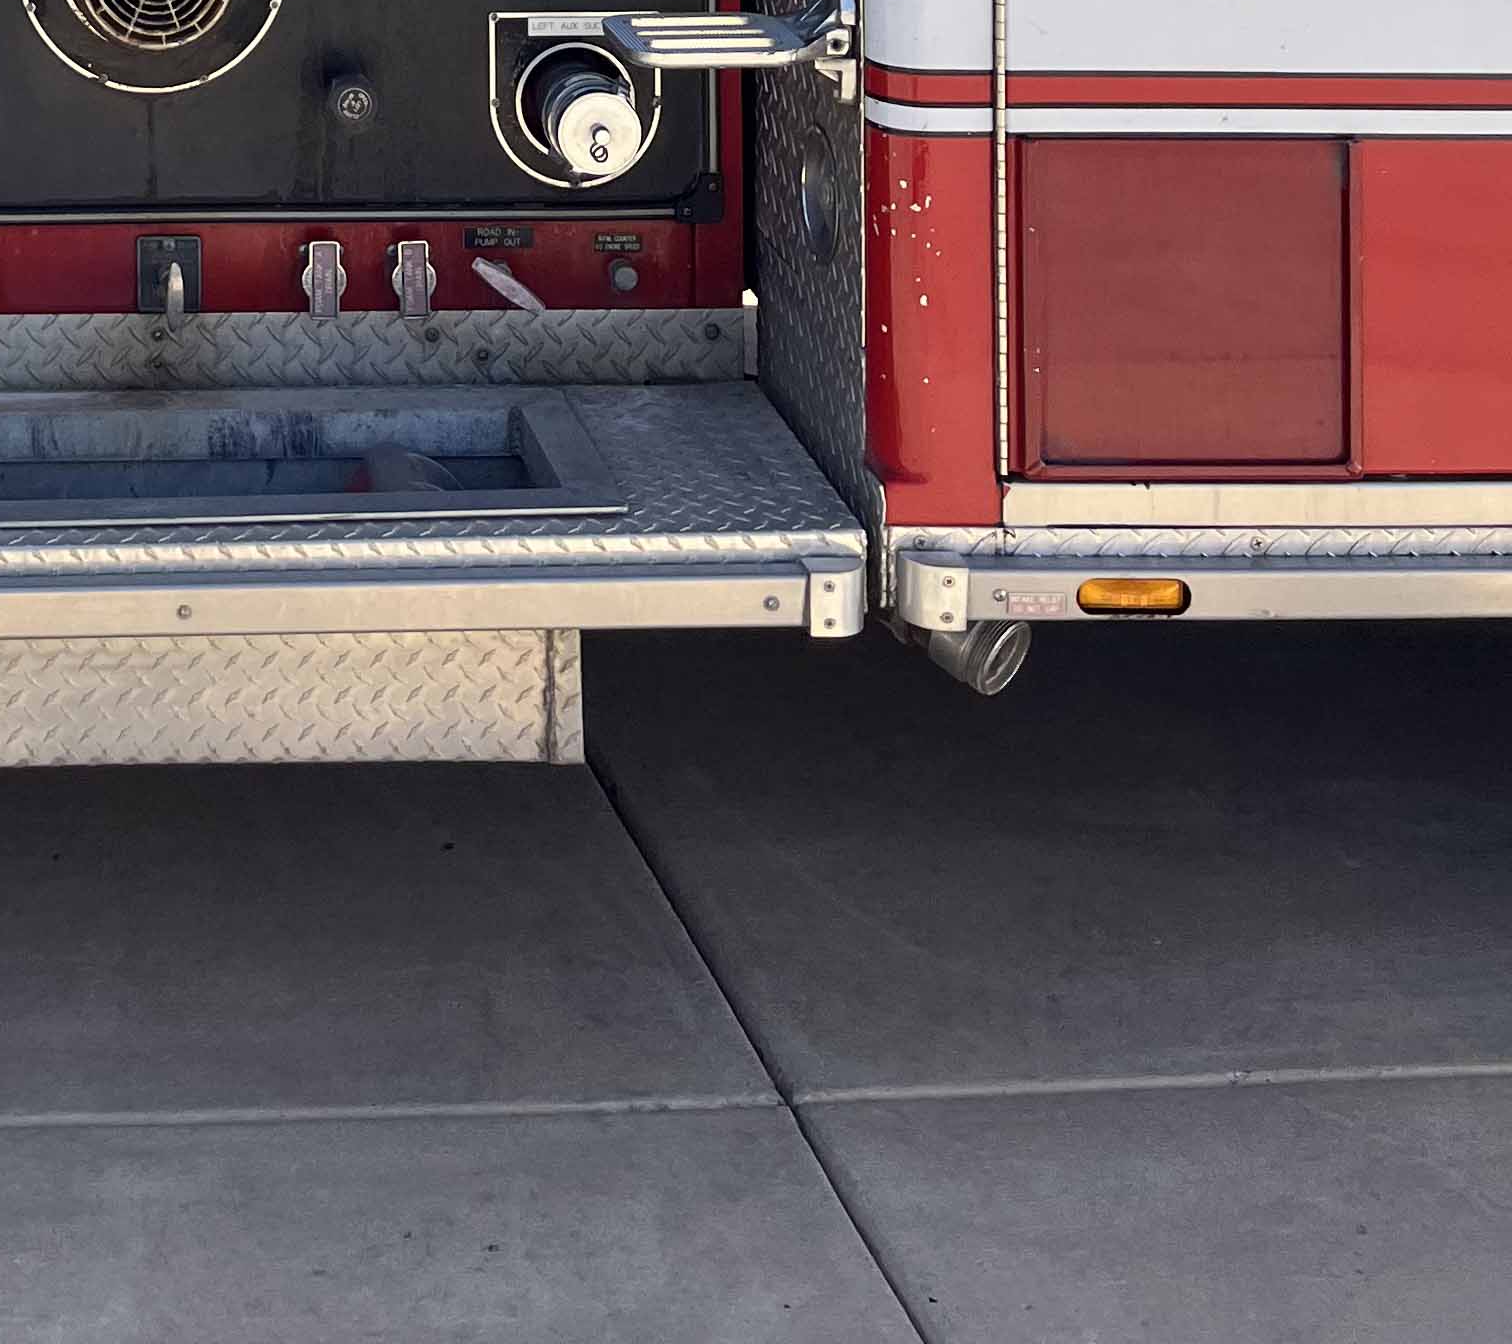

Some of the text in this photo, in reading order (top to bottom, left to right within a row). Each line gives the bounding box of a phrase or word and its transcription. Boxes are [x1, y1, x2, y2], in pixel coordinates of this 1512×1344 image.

[532, 22, 554, 31] LEFT
[560, 22, 578, 31] AUX
[476, 228, 501, 237] ROAD
[474, 237, 520, 247] PUMP OUT
